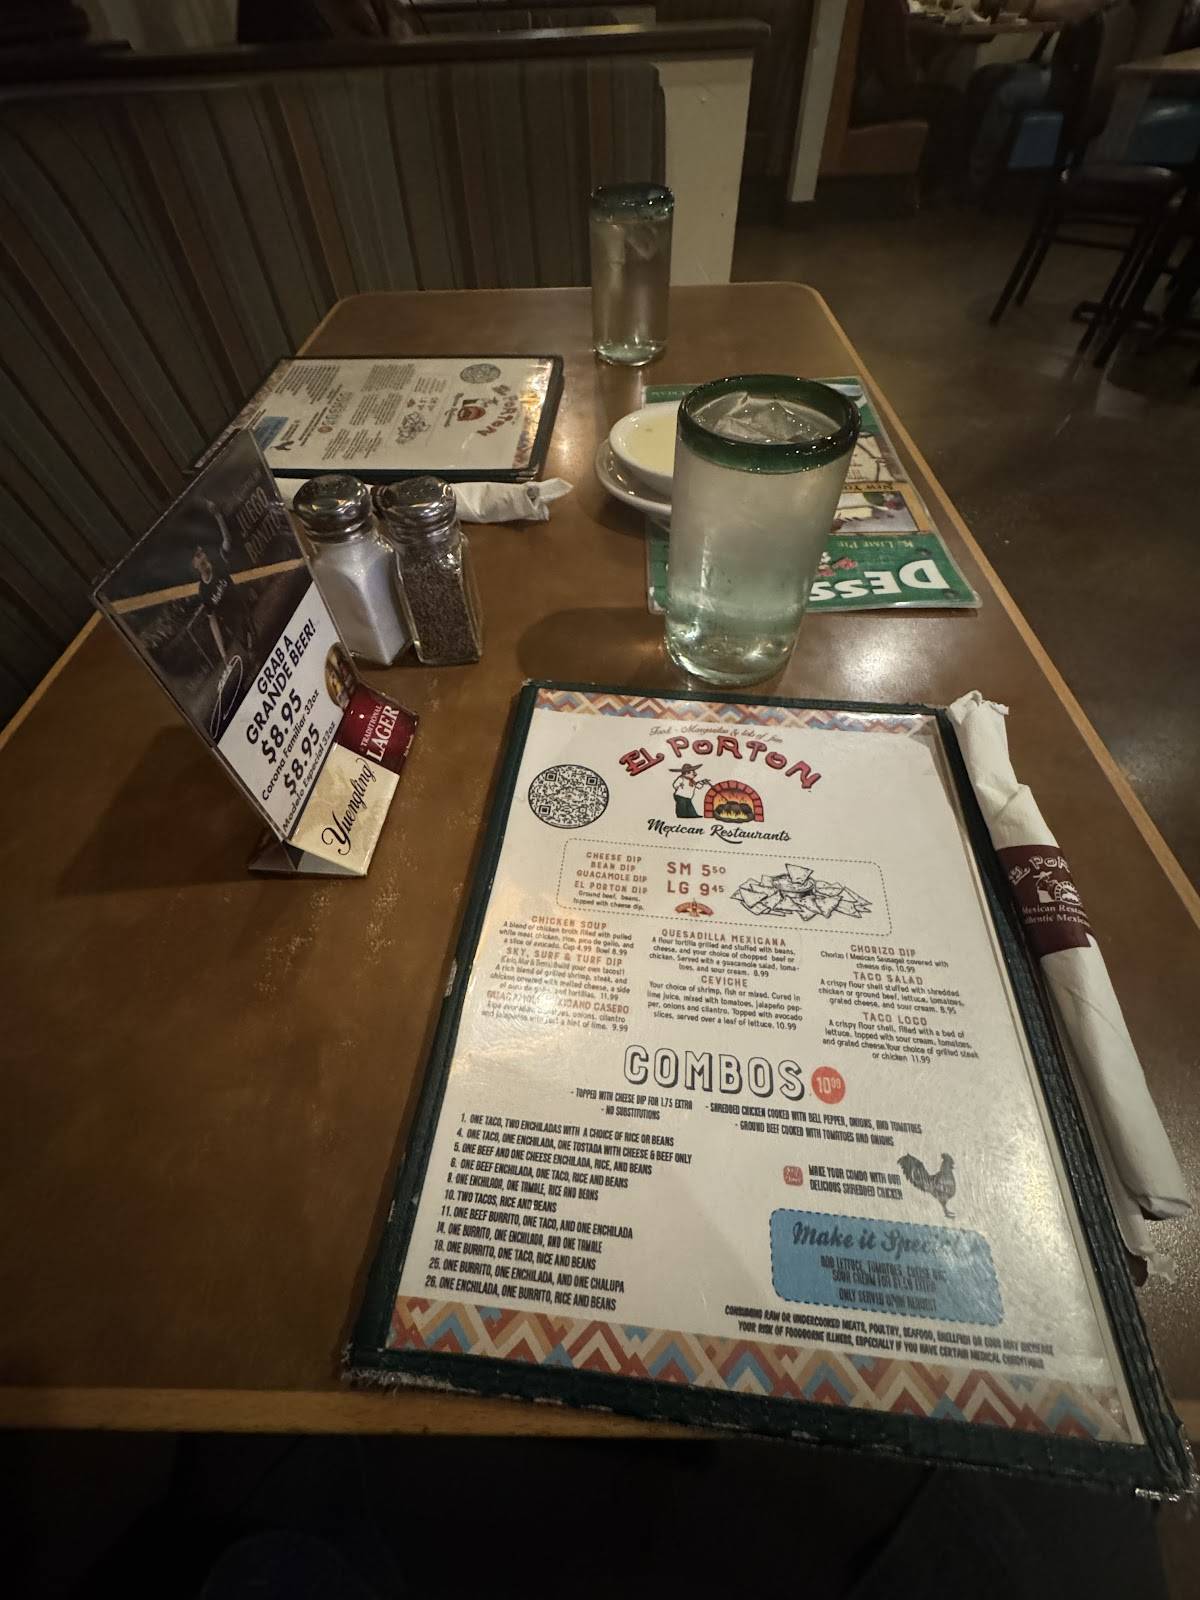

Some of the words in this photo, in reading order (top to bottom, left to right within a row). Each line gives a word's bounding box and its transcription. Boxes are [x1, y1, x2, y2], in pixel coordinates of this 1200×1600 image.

[257, 647, 285, 694] GRAB
[284, 635, 293, 652] A
[247, 662, 292, 744] GRANDE
[289, 618, 315, 667] BEER!
[262, 688, 302, 764] $8.95
[360, 705, 382, 746] TRADITIONAL
[366, 705, 400, 762] LAGER
[262, 758, 286, 801] Corona
[283, 714, 306, 758] Familiar
[304, 689, 319, 715] 32oz
[284, 722, 320, 796] $8.95
[618, 748, 665, 776] EL
[666, 735, 822, 790] PORTON
[282, 788, 304, 832] Modelo
[303, 743, 324, 788] Especial
[322, 721, 336, 747] 32oz
[322, 758, 376, 856] Yuengling
[648, 818, 704, 837] Mexican
[710, 824, 792, 844] Restaurants
[586, 851, 622, 862] CHEESE
[626, 855, 642, 863] DIP
[590, 861, 615, 870] BEAN
[620, 863, 636, 872] DIP
[667, 861, 691, 875] SM
[574, 880, 585, 888] EL
[589, 882, 627, 893] PORTON
[631, 885, 648, 894] DIP
[576, 869, 630, 882] GUACAMOLE
[632, 875, 648, 883] DIP
[667, 880, 689, 895] LG
[531, 915, 575, 928] CHICKEN
[581, 921, 607, 930] SOUP
[661, 928, 726, 942] QUESADILLA
[731, 934, 787, 947] MEXICANA
[850, 944, 895, 956] CHORIZO
[899, 948, 916, 957] DIP
[506, 947, 530, 957] SKY,
[534, 951, 559, 961] SURF
[576, 954, 601, 965] TURF
[605, 956, 623, 966] DIP
[701, 975, 748, 988] CEVICHE
[853, 971, 882, 982] TACO
[887, 974, 923, 985] SALAD
[862, 1011, 892, 1022] TACO
[897, 1014, 928, 1026] LOCO
[623, 1044, 806, 1102] COMBOS
[576, 1088, 597, 1100] TOPPED
[598, 1090, 613, 1100] WITH
[615, 1092, 635, 1104] CHEESE
[637, 1094, 646, 1105] DIP
[648, 1096, 658, 1106] FOR
[661, 1098, 673, 1108] 1.75
[675, 1099, 693, 1110] EXTRA
[616, 1106, 660, 1120] SUBSTITUTIONS
[767, 1108, 789, 1119] COOKED
[461, 1113, 466, 1122] 1.
[470, 1114, 484, 1124] ONE
[484, 1115, 504, 1128] TACO,
[504, 1118, 520, 1129] TWO
[520, 1120, 562, 1134] ENCHILADAS
[562, 1125, 580, 1136] WITH
[583, 1127, 588, 1137] A
[589, 1128, 613, 1140] CHOICE
[614, 1130, 623, 1141] OF
[624, 1132, 640, 1143] RICE
[640, 1134, 650, 1144] OR
[651, 1135, 674, 1147] BEANS
[453, 1142, 460, 1152] 5.
[461, 1143, 477, 1154] ONE
[477, 1144, 495, 1156] BEEF
[495, 1146, 510, 1158] AND
[510, 1148, 525, 1160] ONE
[526, 1150, 552, 1163] CHEESE
[553, 1153, 593, 1169] ENCHILADA,
[594, 1158, 612, 1171] RICE,
[613, 1161, 628, 1172] AND
[629, 1163, 653, 1175] BEANS
[456, 1128, 463, 1137] 4.
[466, 1128, 481, 1140] ONE
[482, 1130, 500, 1144] TACO,
[501, 1133, 516, 1144] ONE
[516, 1134, 556, 1150] ENCHILADA,
[557, 1139, 572, 1150] ONE
[573, 1140, 602, 1154] TOSTADA
[603, 1145, 621, 1156] WITH
[622, 1147, 648, 1160] CHEESE
[656, 1151, 674, 1162] BEEF
[674, 1153, 692, 1165] ONLY
[450, 1157, 457, 1168] 6.
[460, 1159, 475, 1170] ONE
[475, 1160, 494, 1172] BEEF
[494, 1163, 534, 1178] ENCHILADA,
[536, 1168, 550, 1179] ONE
[551, 1169, 570, 1183] TACO,
[572, 1172, 589, 1183] RICE
[589, 1174, 604, 1186] AND
[605, 1175, 629, 1188] BEANS
[441, 1205, 452, 1217] 11.
[453, 1206, 469, 1219] ONE
[469, 1208, 488, 1221] BEEF
[489, 1211, 521, 1225] BURRITO,
[522, 1215, 537, 1228] ONE
[539, 1217, 559, 1232] TACO,
[560, 1220, 576, 1232] AND
[576, 1221, 591, 1234] ONE
[592, 1223, 633, 1240] ENCHILADA
[793, 1221, 854, 1249] Make
[860, 1228, 878, 1250] it
